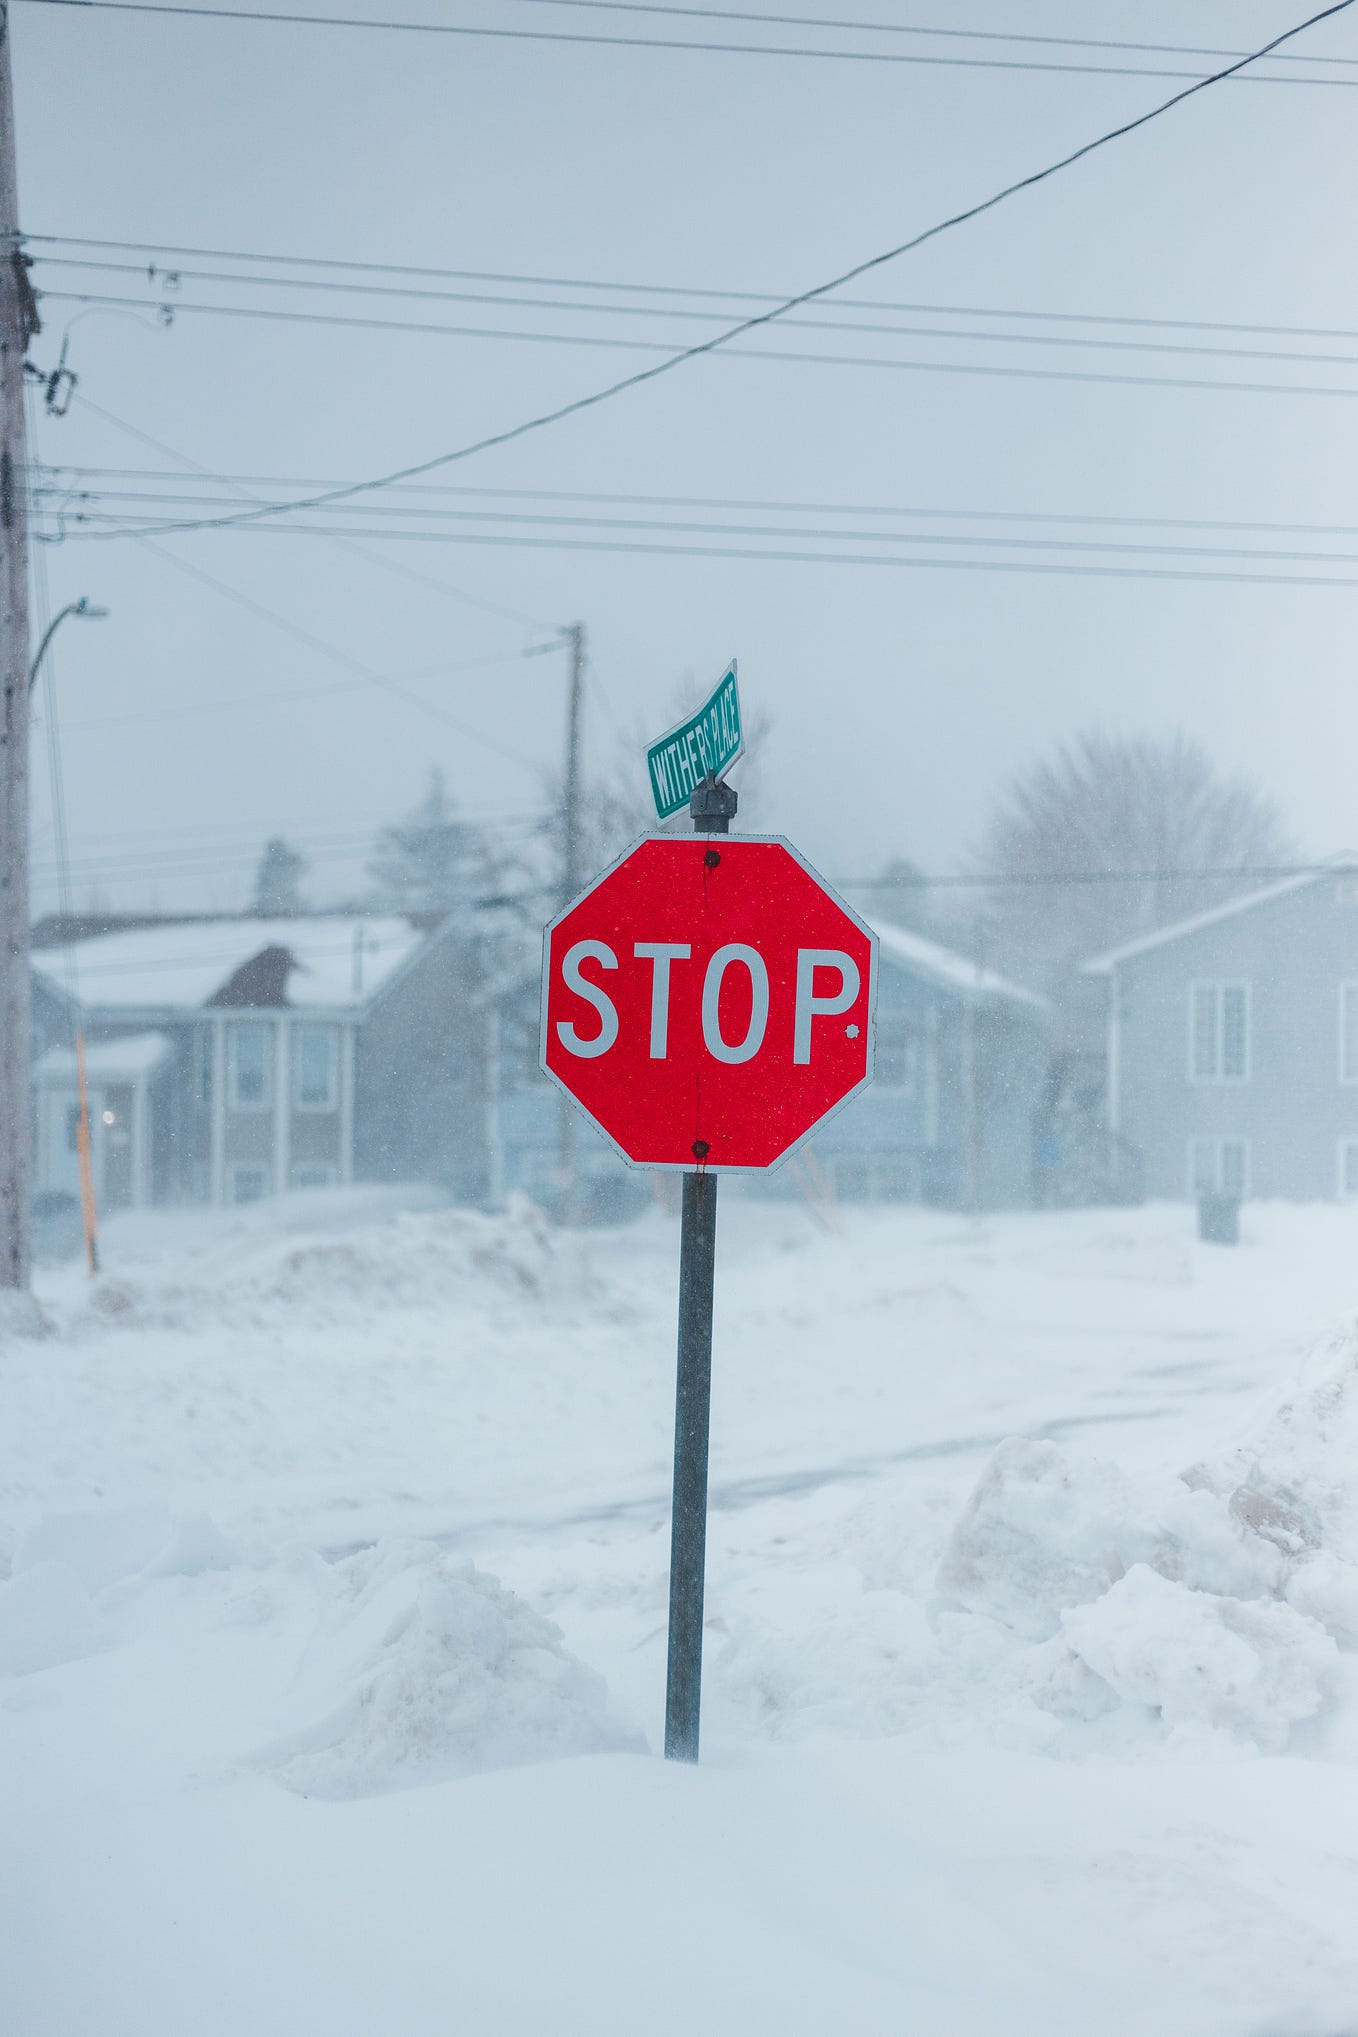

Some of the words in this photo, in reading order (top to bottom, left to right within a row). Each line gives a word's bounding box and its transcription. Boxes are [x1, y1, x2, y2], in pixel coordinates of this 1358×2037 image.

[651, 718, 714, 809] WITHERS
[710, 681, 738, 768] PLACE
[556, 939, 860, 1065] STOP
